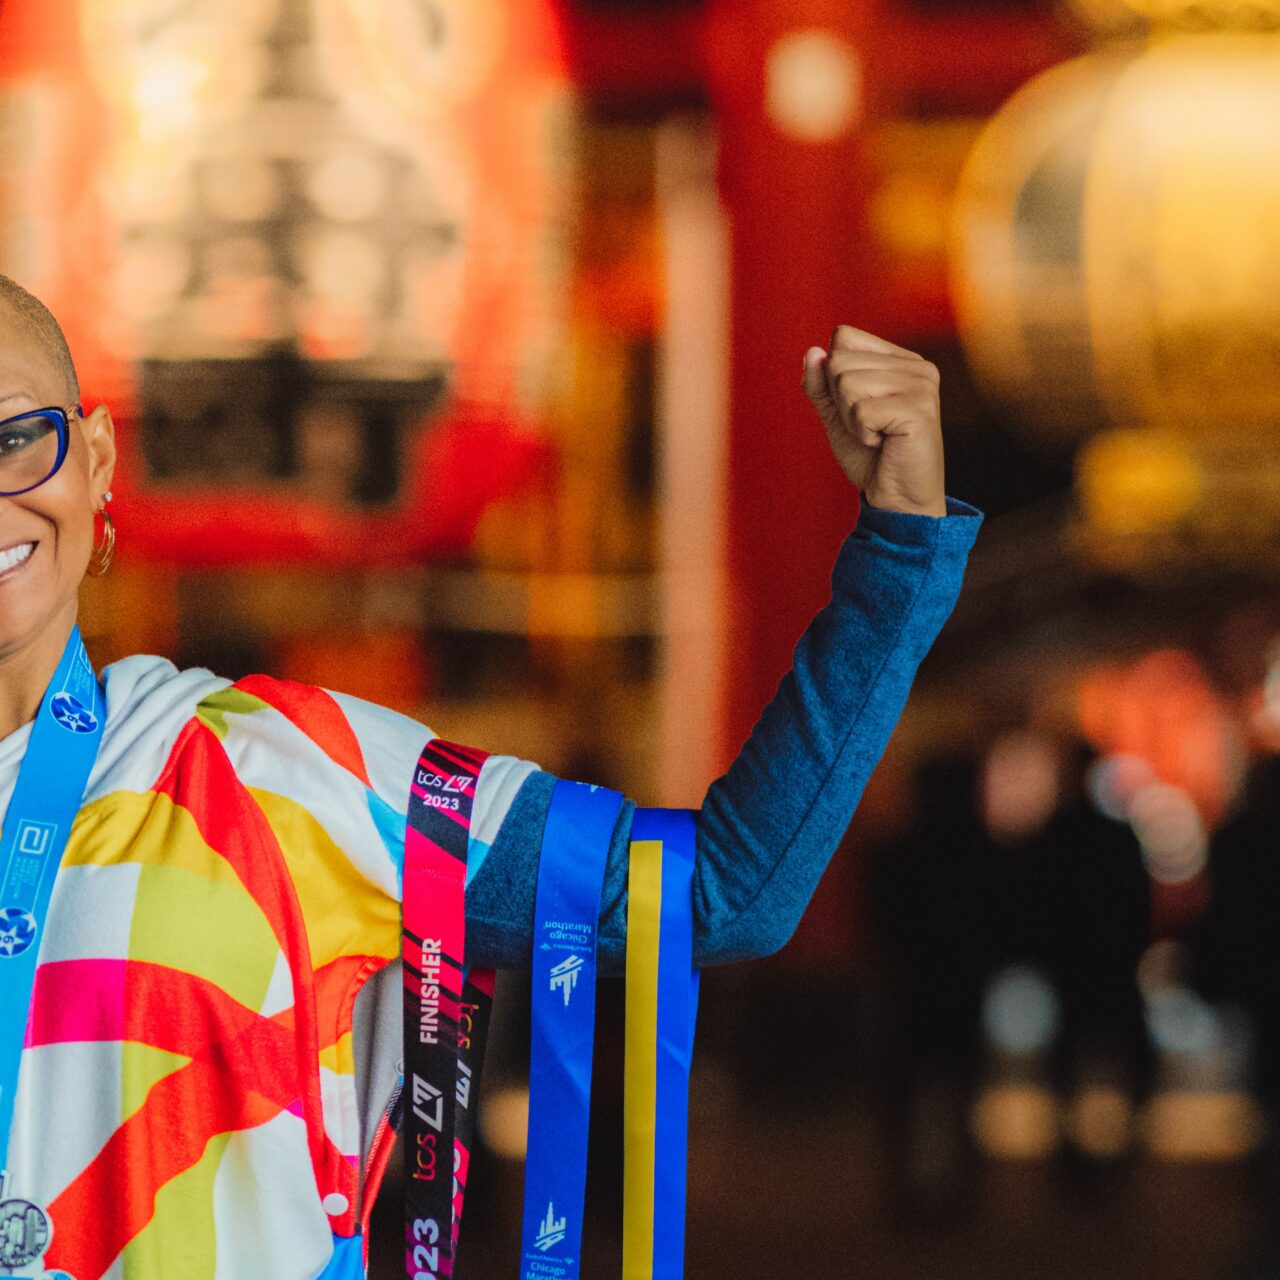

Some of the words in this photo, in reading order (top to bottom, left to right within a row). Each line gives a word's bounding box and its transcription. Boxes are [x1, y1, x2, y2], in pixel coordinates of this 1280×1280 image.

[417, 769, 442, 787] tcs
[422, 793, 459, 811] 2023
[545, 920, 592, 934] Marathon
[550, 930, 588, 944] Chicago
[419, 938, 442, 1044] FINISHER
[412, 1133, 436, 1181] tcs
[530, 1261, 566, 1277] Chicago
